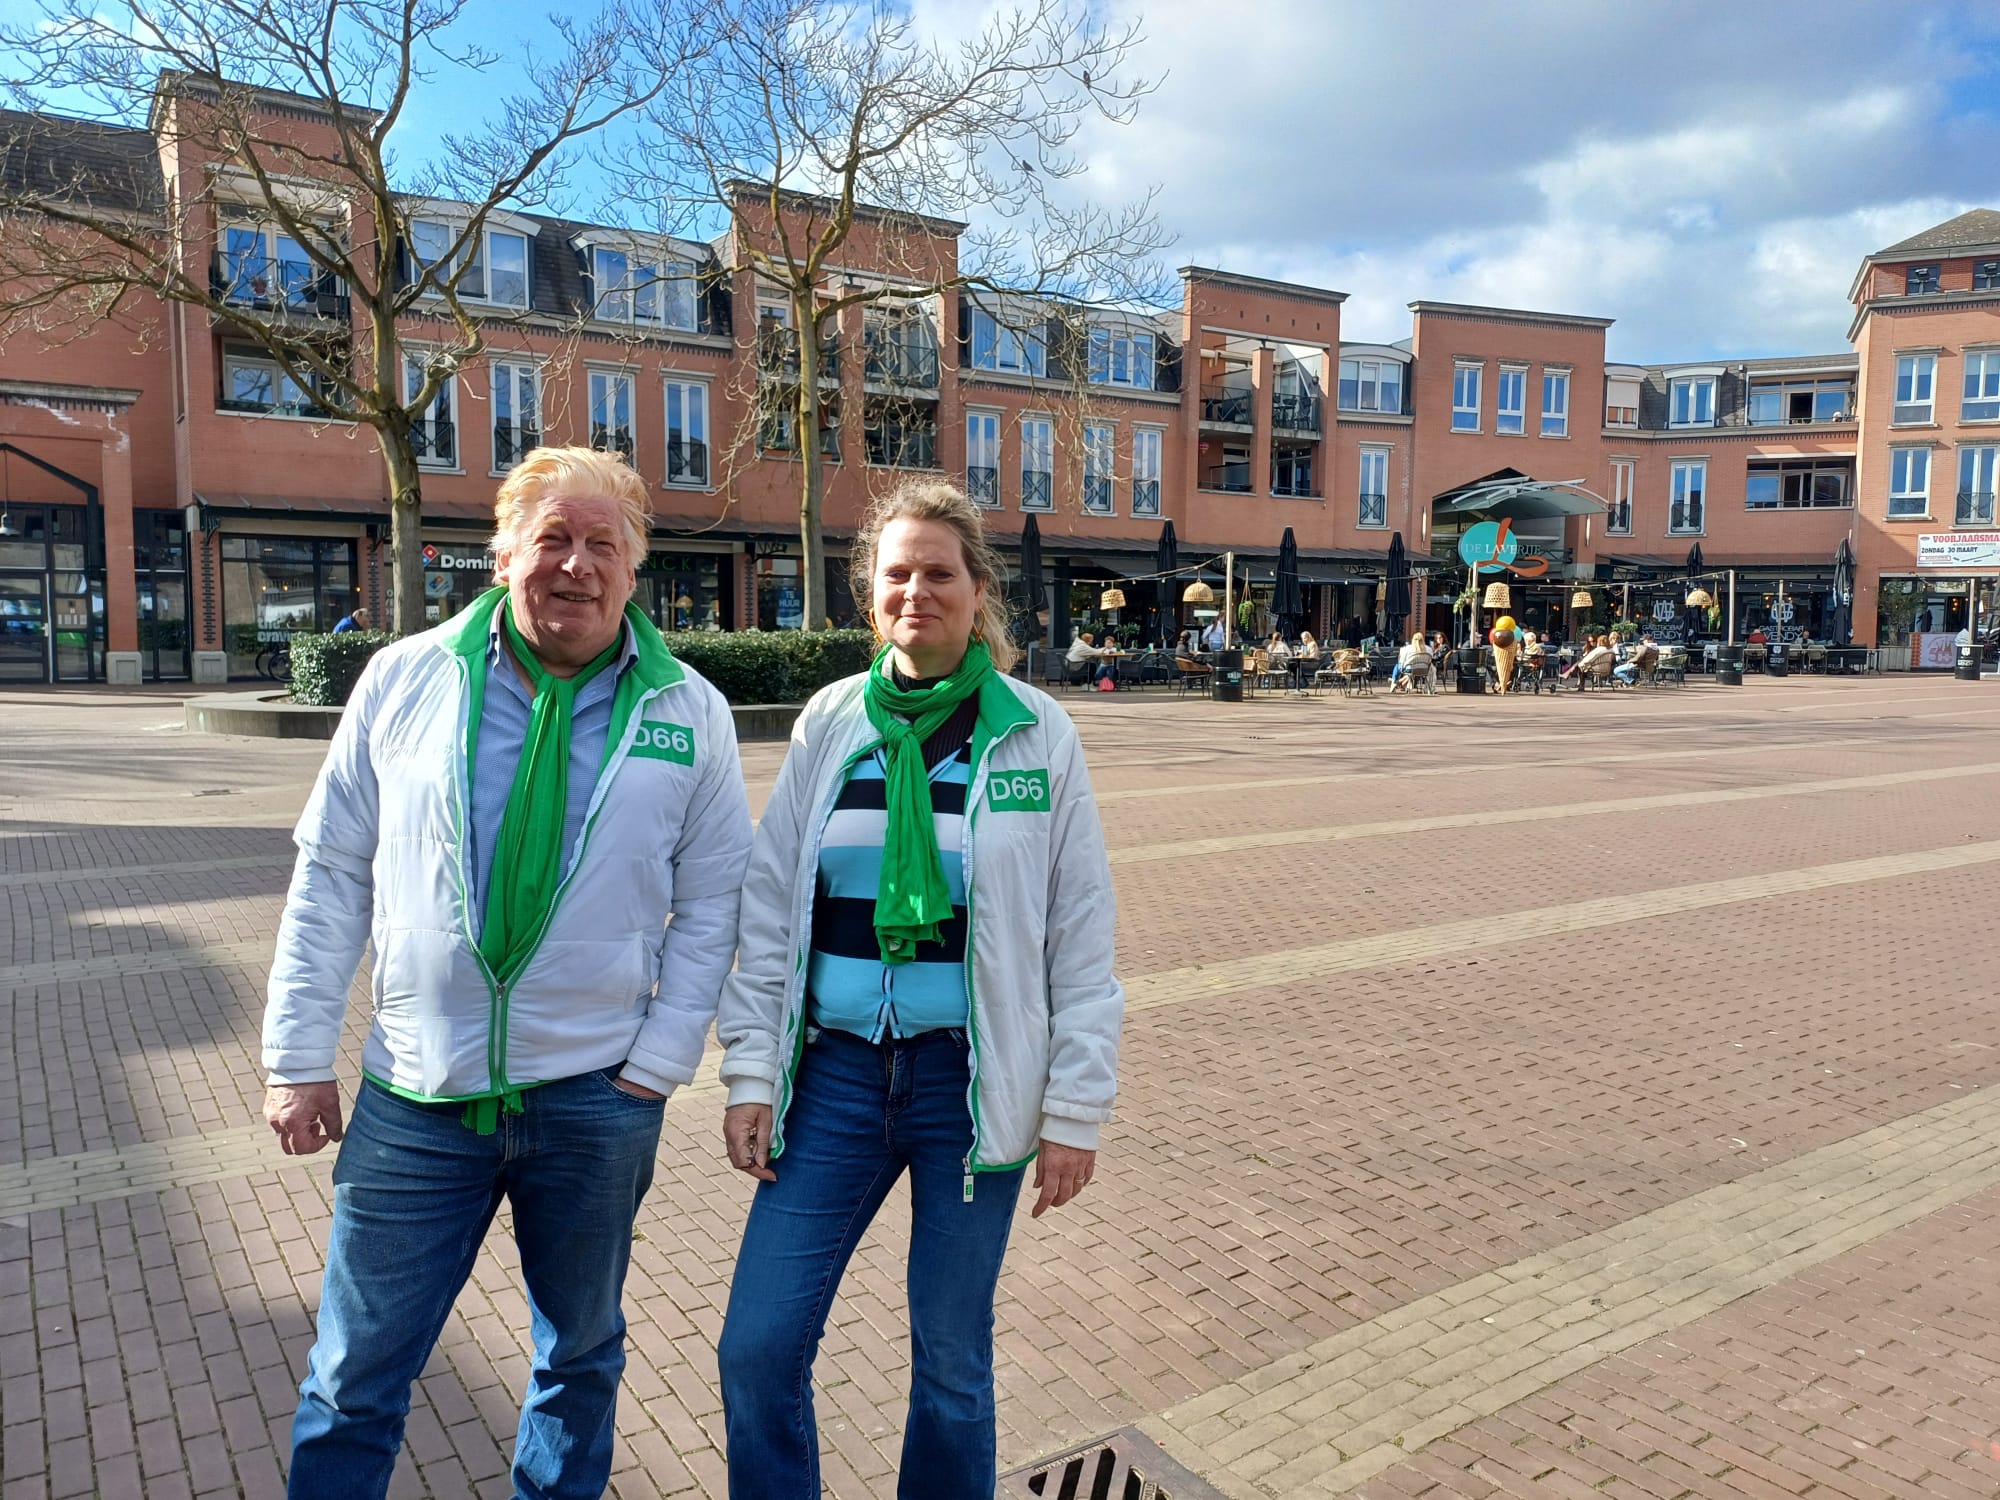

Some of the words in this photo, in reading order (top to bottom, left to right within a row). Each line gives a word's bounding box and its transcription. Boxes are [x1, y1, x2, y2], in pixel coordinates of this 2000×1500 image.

[1465, 544, 1481, 553] DE
[631, 726, 689, 753] D66
[990, 776, 1044, 801] D66
